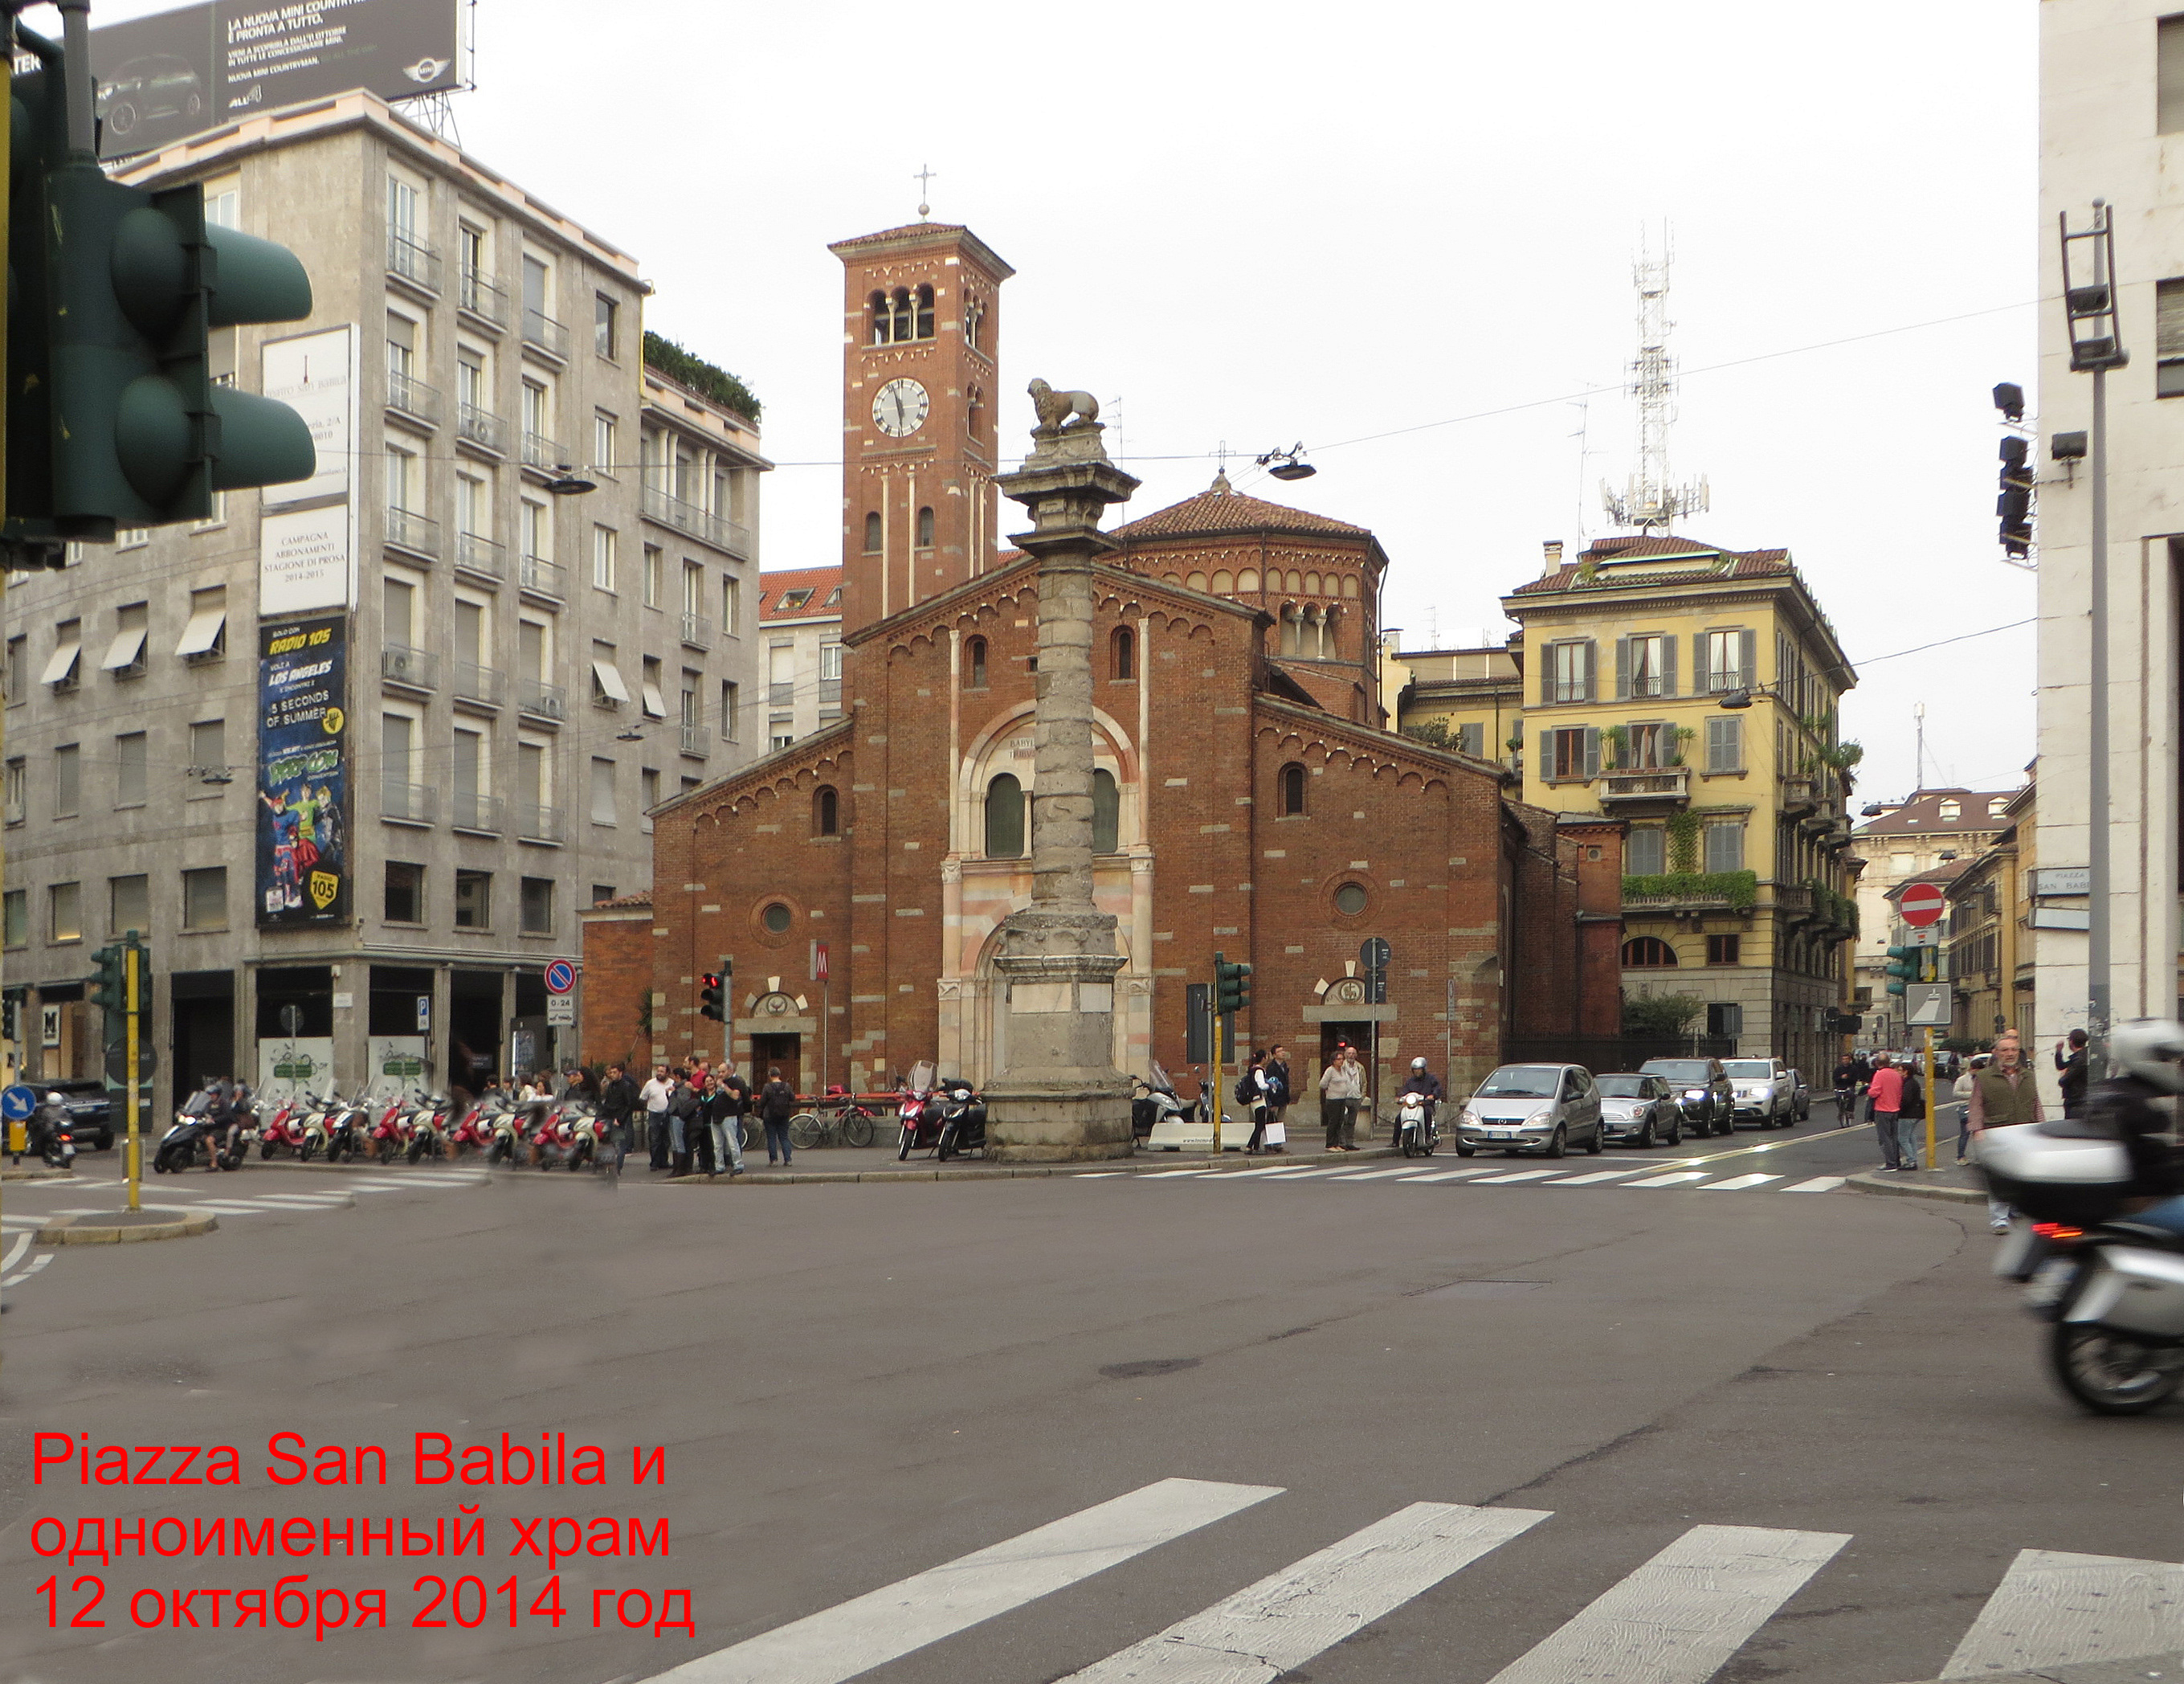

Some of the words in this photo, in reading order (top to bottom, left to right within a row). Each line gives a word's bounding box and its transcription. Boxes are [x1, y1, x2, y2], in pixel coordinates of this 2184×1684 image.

[228, 18, 242, 32] LA
[243, 9, 280, 29] NUOVA
[281, 3, 304, 19] MINI
[236, 22, 276, 43] PRONTA
[277, 20, 286, 33] A
[287, 12, 324, 31] TUTTO.
[281, 531, 329, 546] CAMPAGNA
[276, 542, 335, 559] ABBONAMENTI
[264, 558, 304, 573] STAGIONE
[307, 558, 317, 566] DI
[319, 554, 345, 565] PROSA
[284, 569, 325, 582] 2014-2015
[268, 633, 308, 655] RADIO
[308, 627, 333, 646] 105
[268, 670, 289, 687] LOS
[288, 660, 333, 682] ANGELES
[271, 703, 278, 714] 5
[280, 690, 330, 712] SECONDS
[267, 716, 280, 728] OF
[284, 707, 327, 725] SUMMER
[312, 881, 334, 899] 105
[2066, 881, 2089, 889] BABI
[817, 951, 827, 973] M
